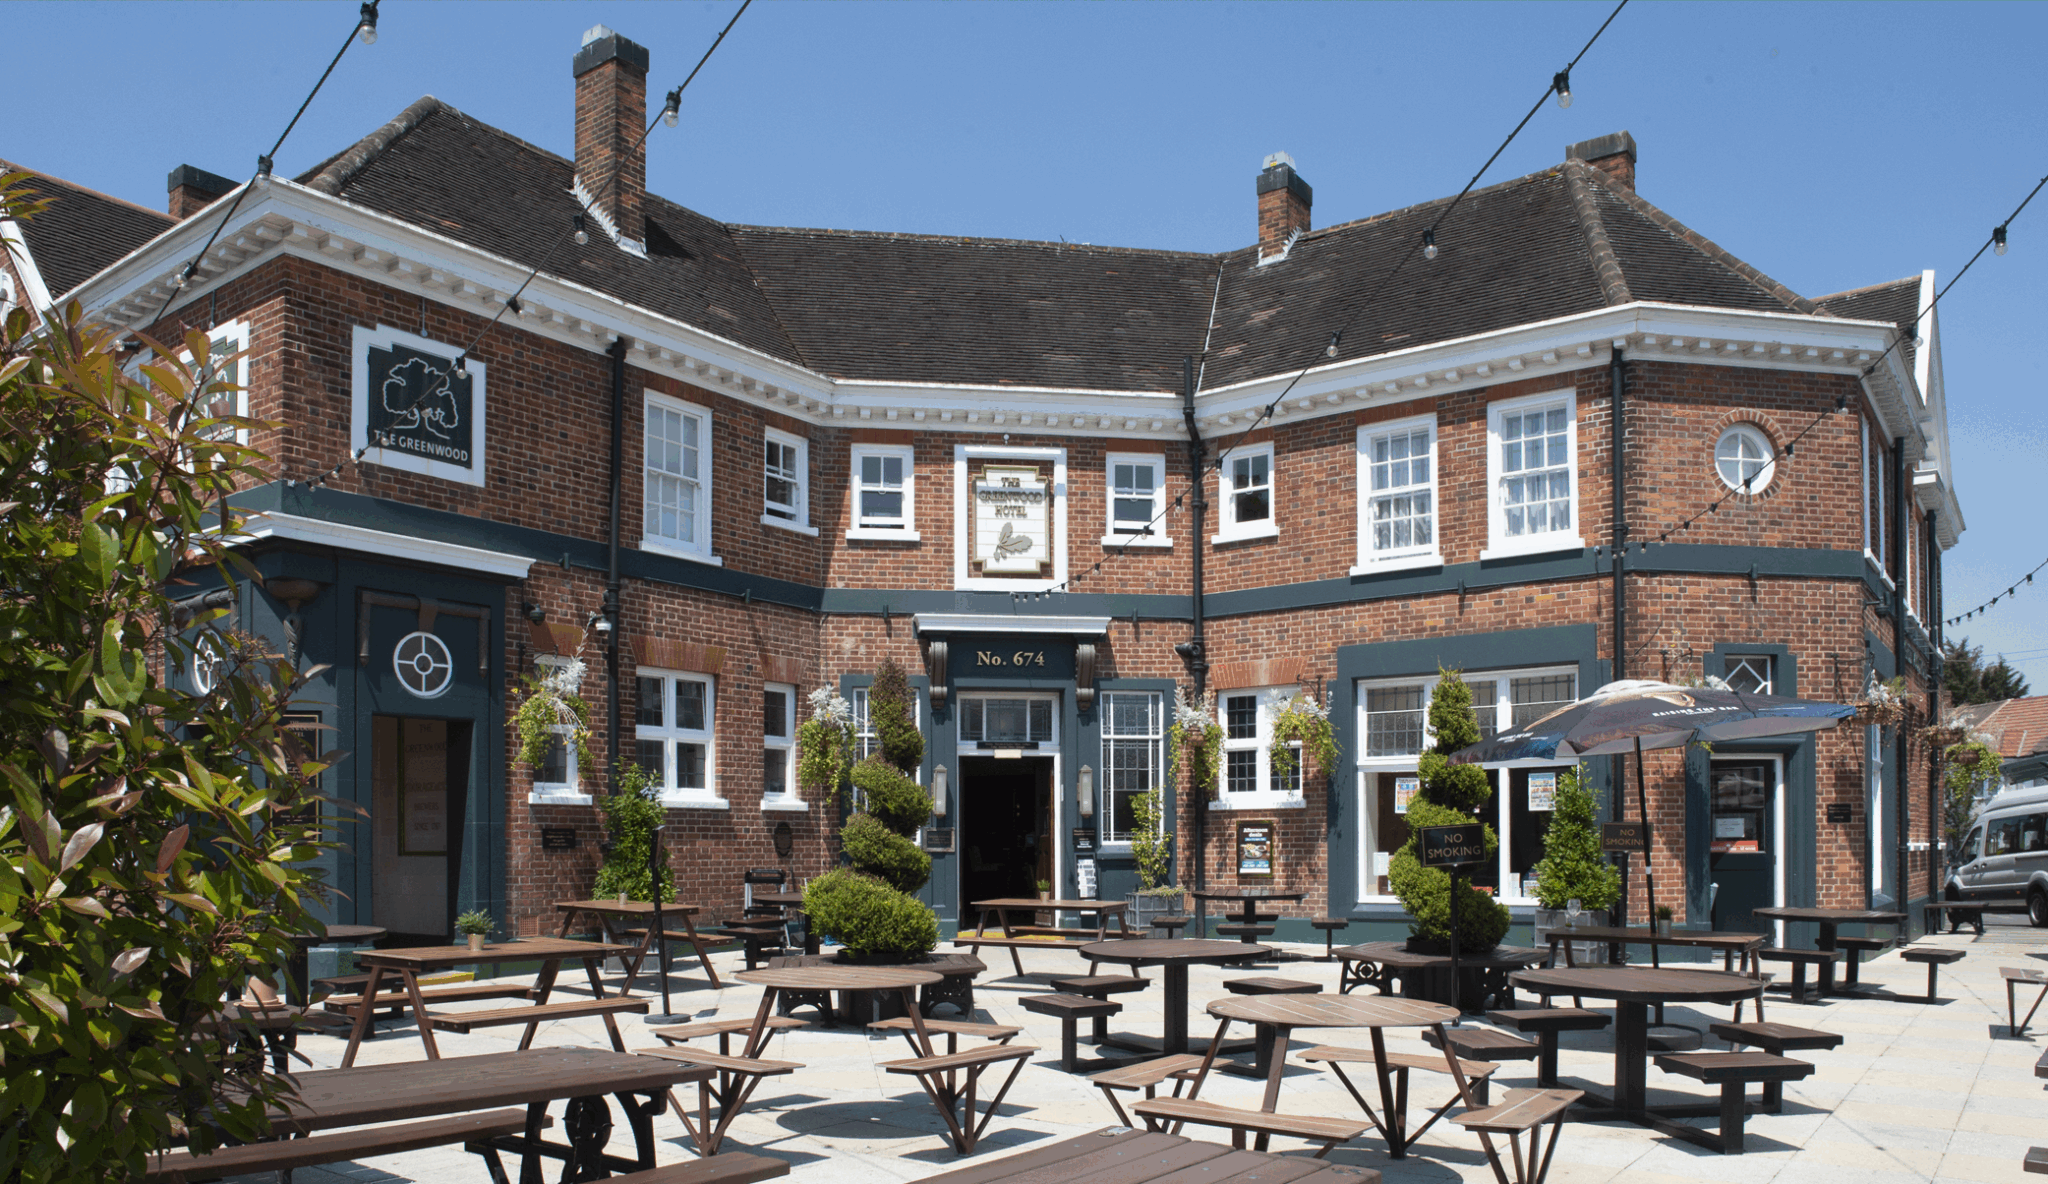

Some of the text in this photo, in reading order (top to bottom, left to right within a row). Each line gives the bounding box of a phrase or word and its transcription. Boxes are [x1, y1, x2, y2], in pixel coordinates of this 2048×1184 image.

[374, 429, 468, 461] TE GREENWOOD
[1001, 477, 1020, 487] THE
[979, 491, 1042, 503] GREENWOOD
[995, 505, 1027, 517] HOTEL
[976, 651, 1045, 667] No. 674
[1652, 708, 1695, 717] RAISING
[1444, 833, 1463, 844] NO
[1619, 829, 1635, 837] NO
[1428, 845, 1481, 859] SMOKING
